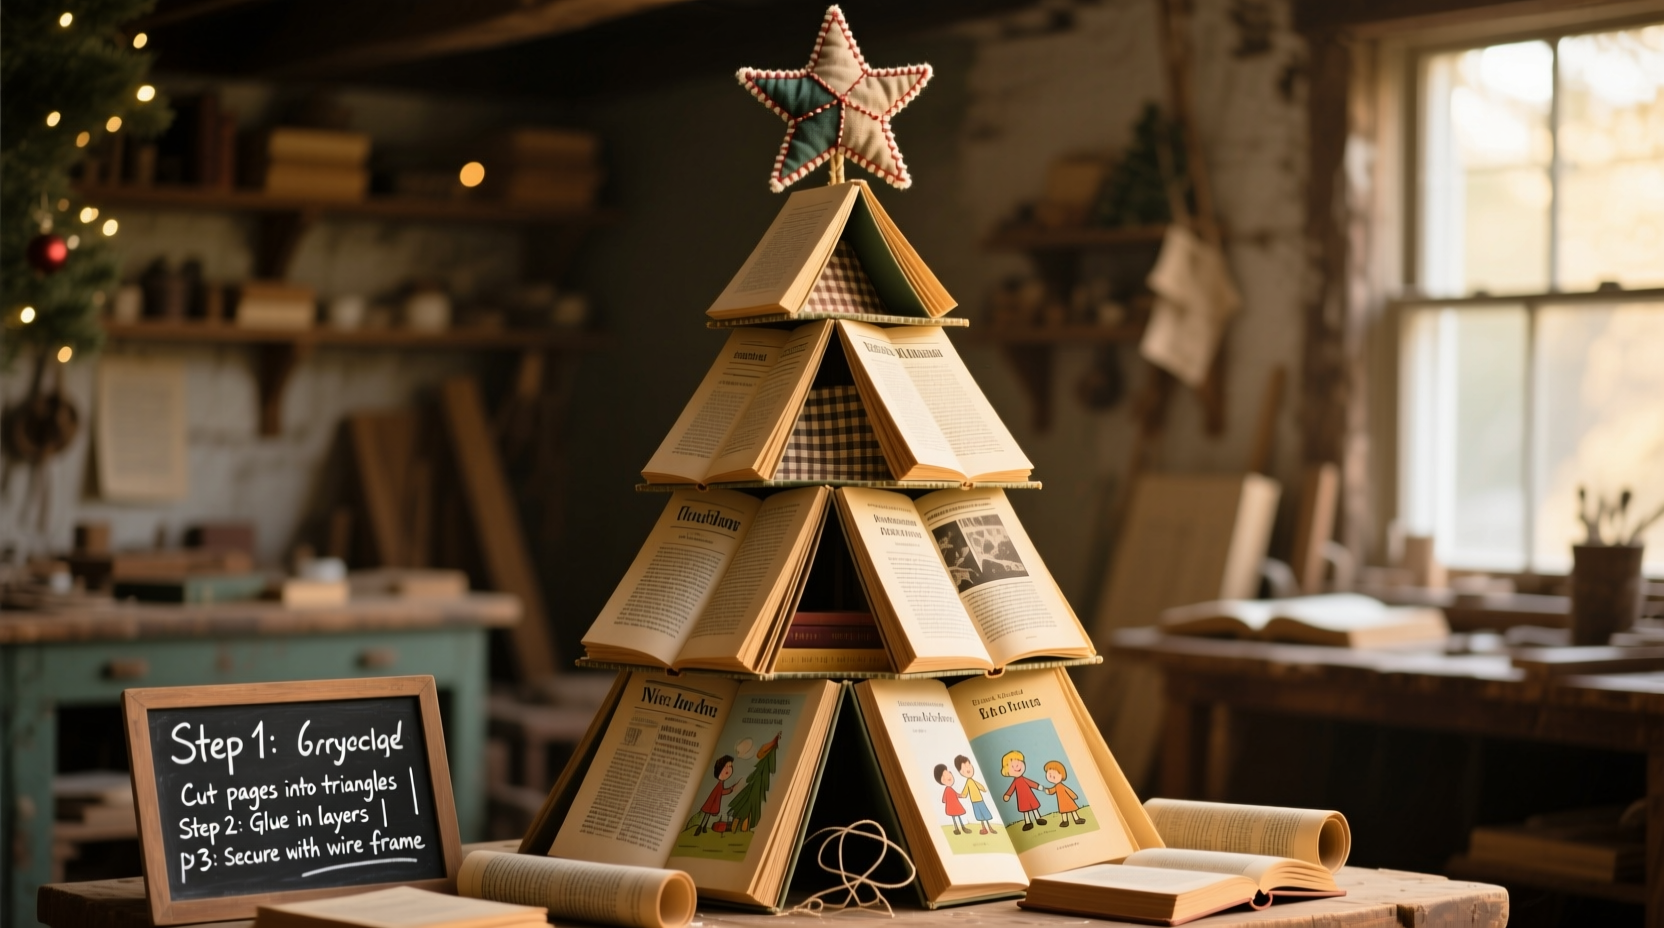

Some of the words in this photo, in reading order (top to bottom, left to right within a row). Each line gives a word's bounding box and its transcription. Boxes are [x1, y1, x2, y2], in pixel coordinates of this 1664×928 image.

[170, 721, 244, 776] Step
[251, 720, 277, 759] 1:
[181, 782, 218, 807] Cut
[227, 784, 279, 811] pages
[285, 776, 317, 799] into
[321, 769, 398, 802] triangles
[179, 816, 220, 846] Step
[224, 816, 243, 836] 2:
[249, 812, 290, 835] Glue
[297, 809, 313, 828] in
[318, 805, 370, 834] layers
[224, 846, 281, 867] Secure
[285, 836, 321, 860] with
[327, 836, 364, 856] wire
[370, 829, 426, 856] frame
